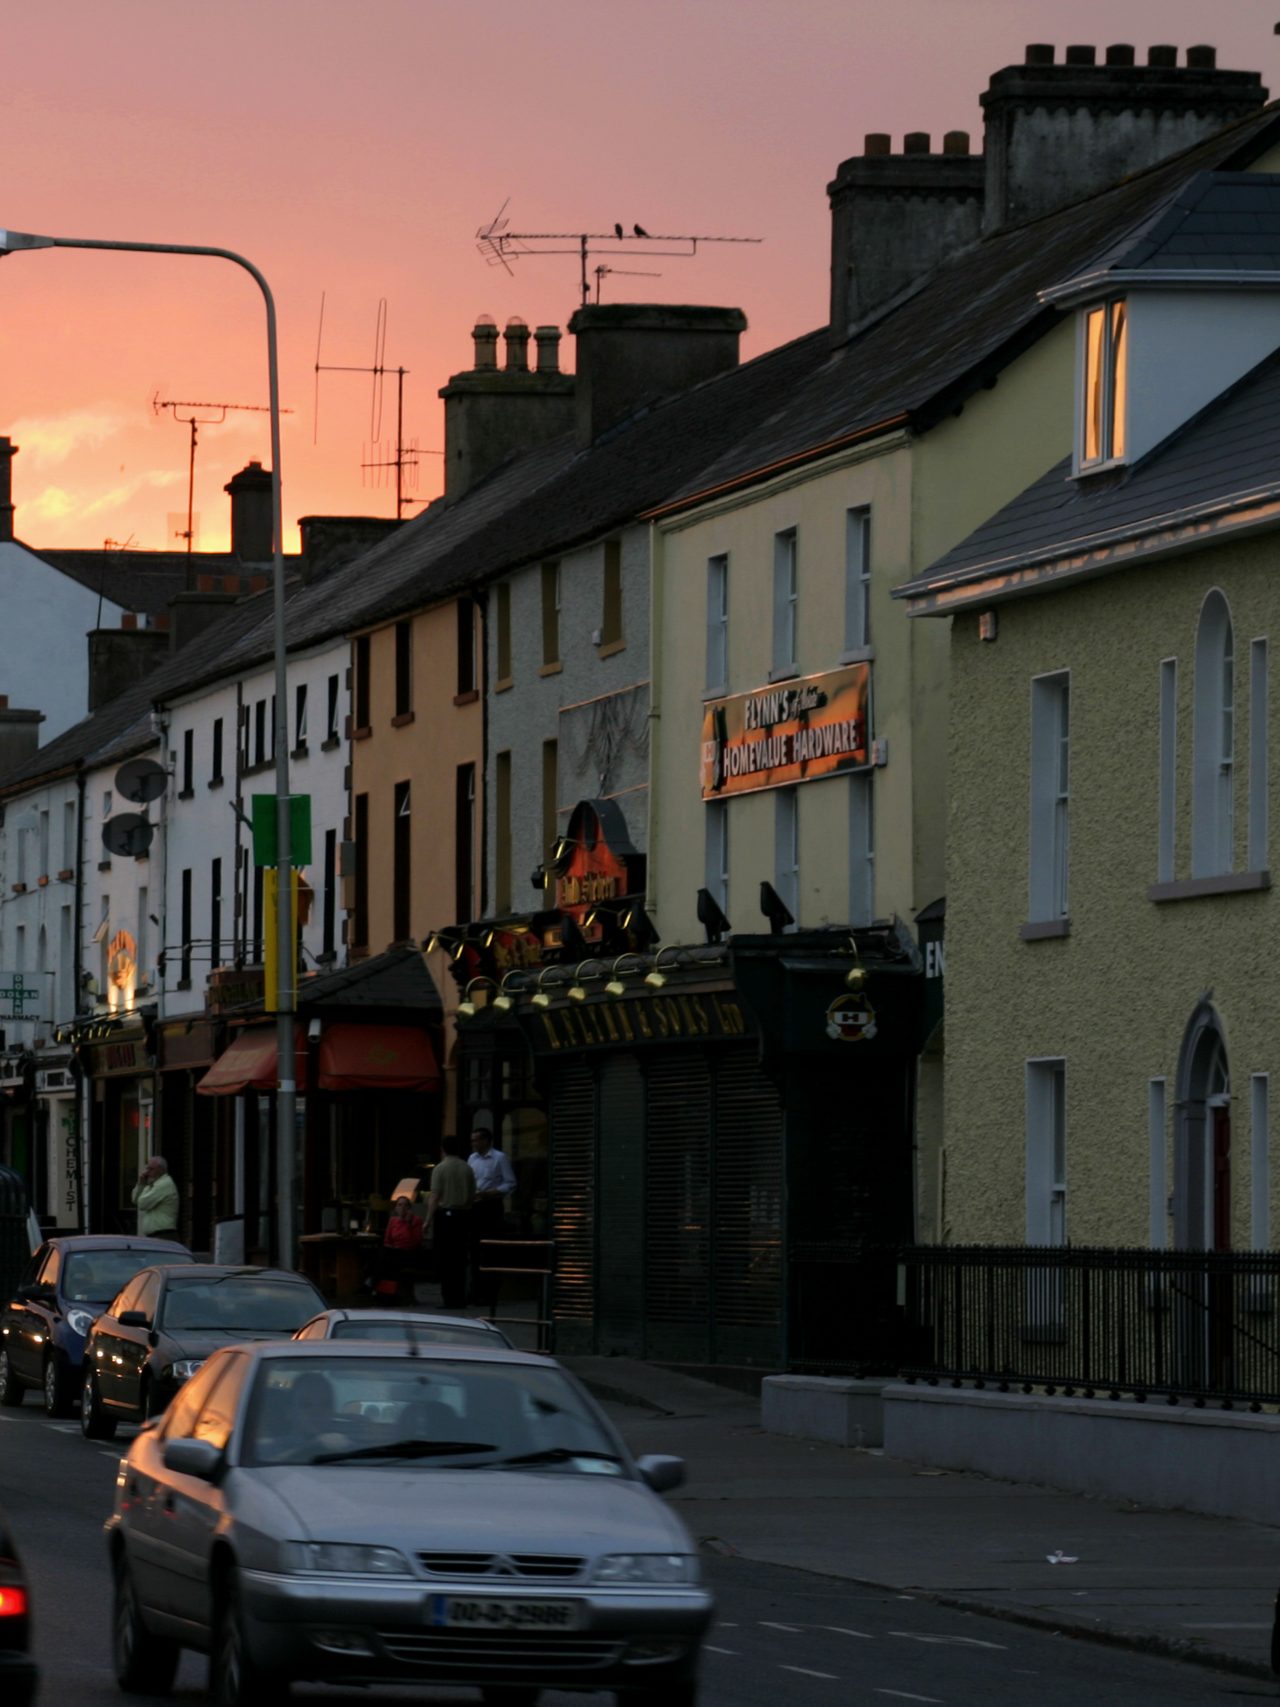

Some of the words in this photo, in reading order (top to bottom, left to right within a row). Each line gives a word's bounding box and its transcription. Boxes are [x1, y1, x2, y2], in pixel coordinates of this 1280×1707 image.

[744, 689, 789, 730] FLYNN'S
[723, 734, 787, 777] HOMEVALUE
[793, 719, 856, 762] HARDWARE
[0, 990, 39, 999] DOLAN
[653, 994, 710, 1037] SONS
[66, 1136, 77, 1212] CHEMIST
